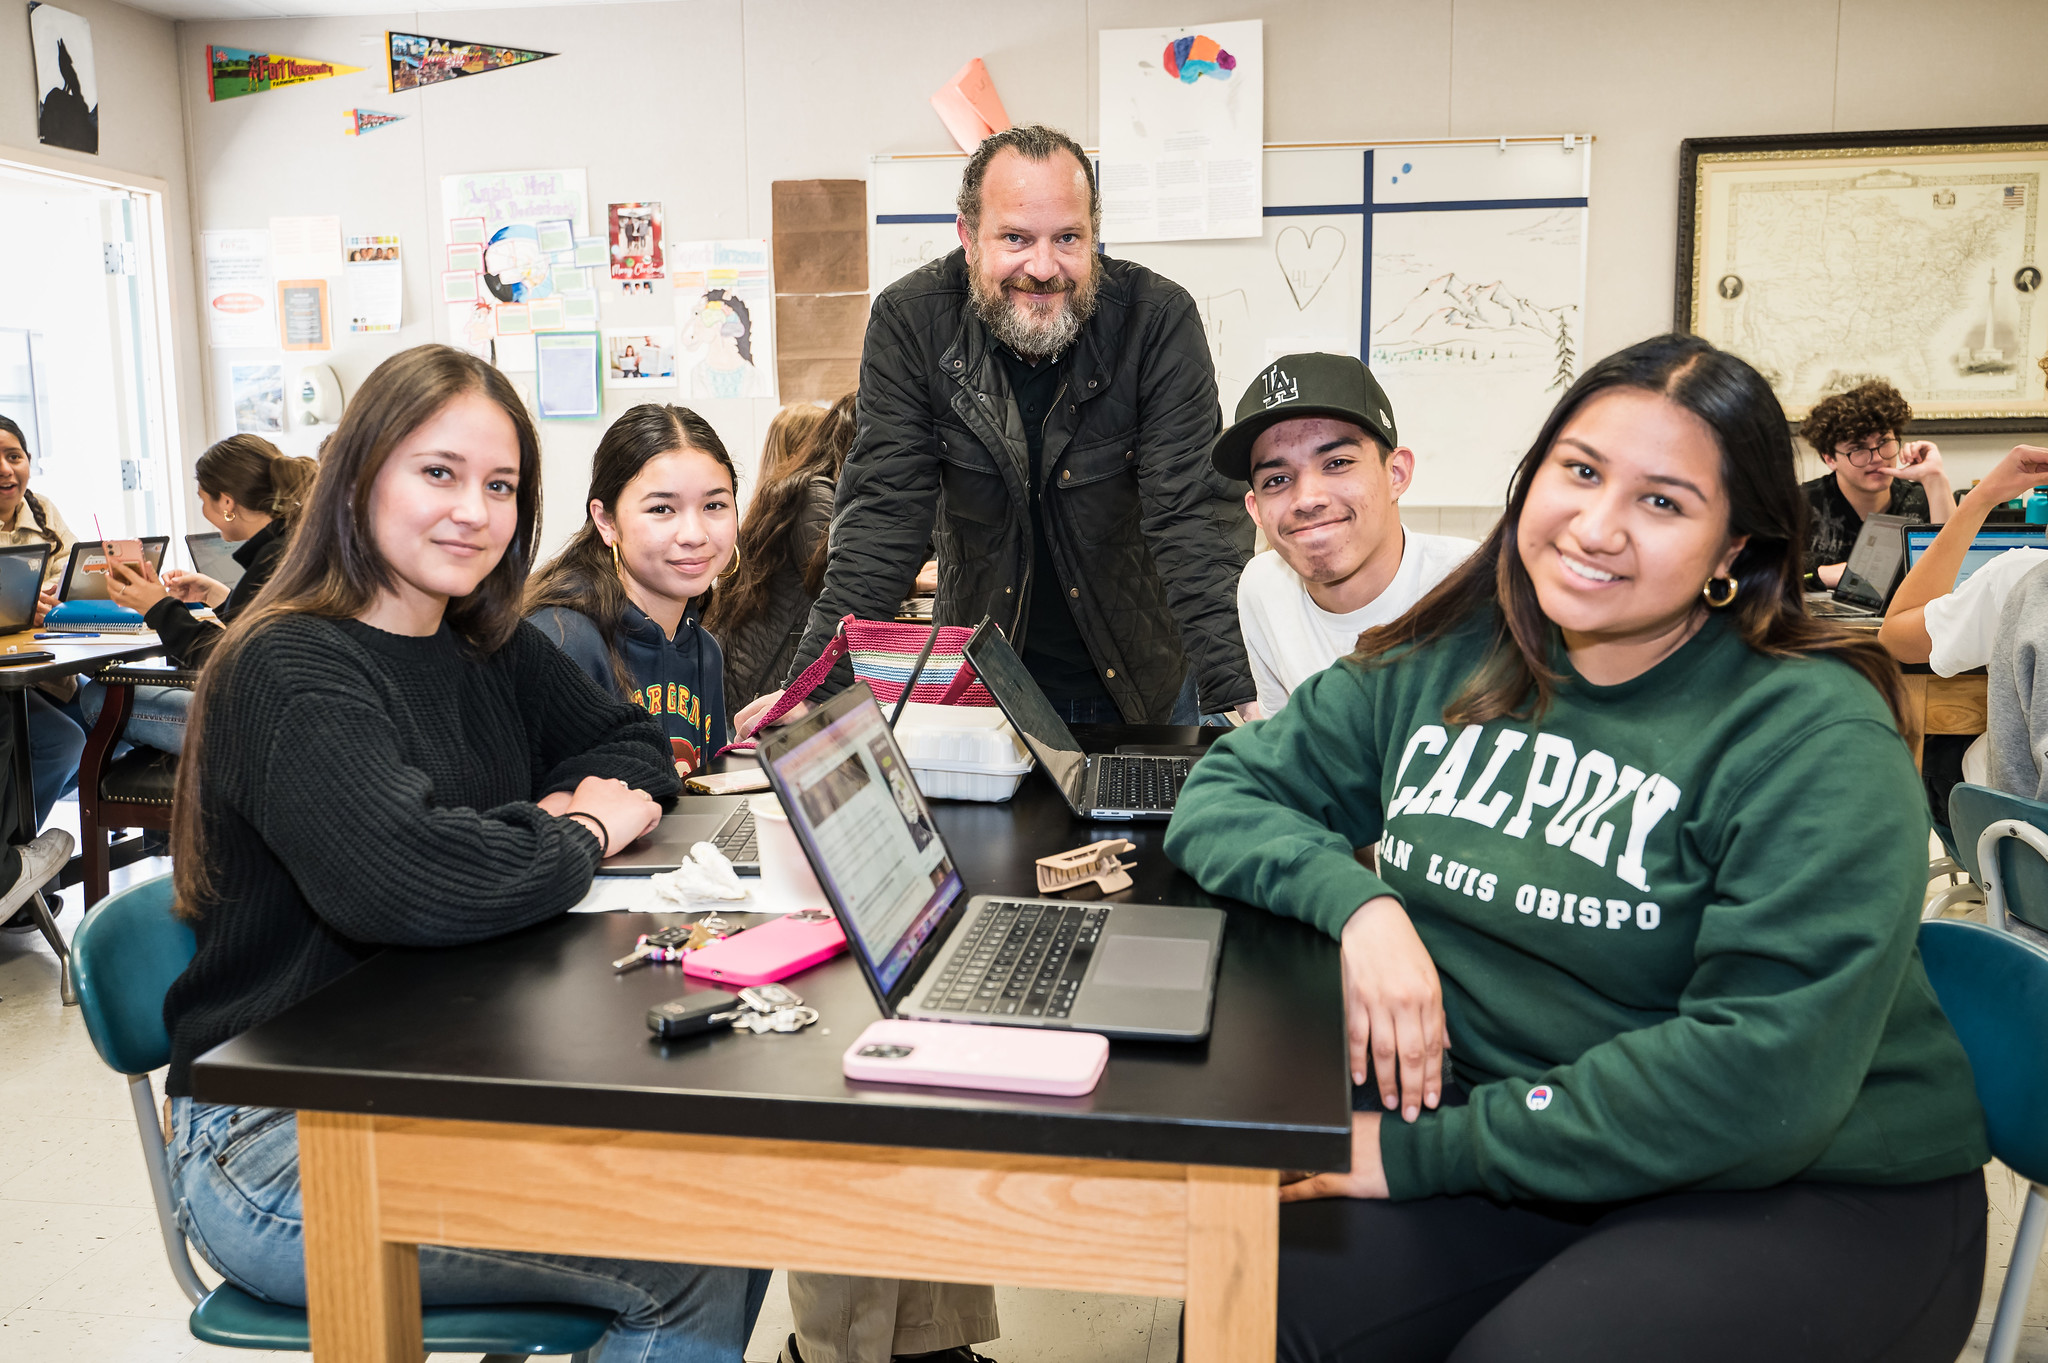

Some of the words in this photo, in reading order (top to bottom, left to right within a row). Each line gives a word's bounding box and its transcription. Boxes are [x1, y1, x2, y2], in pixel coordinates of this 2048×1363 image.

[258, 55, 287, 82] Fort
[1262, 365, 1299, 409] LA
[1426, 853, 1498, 902] LUIS
[1515, 884, 1661, 930] OBISPO
